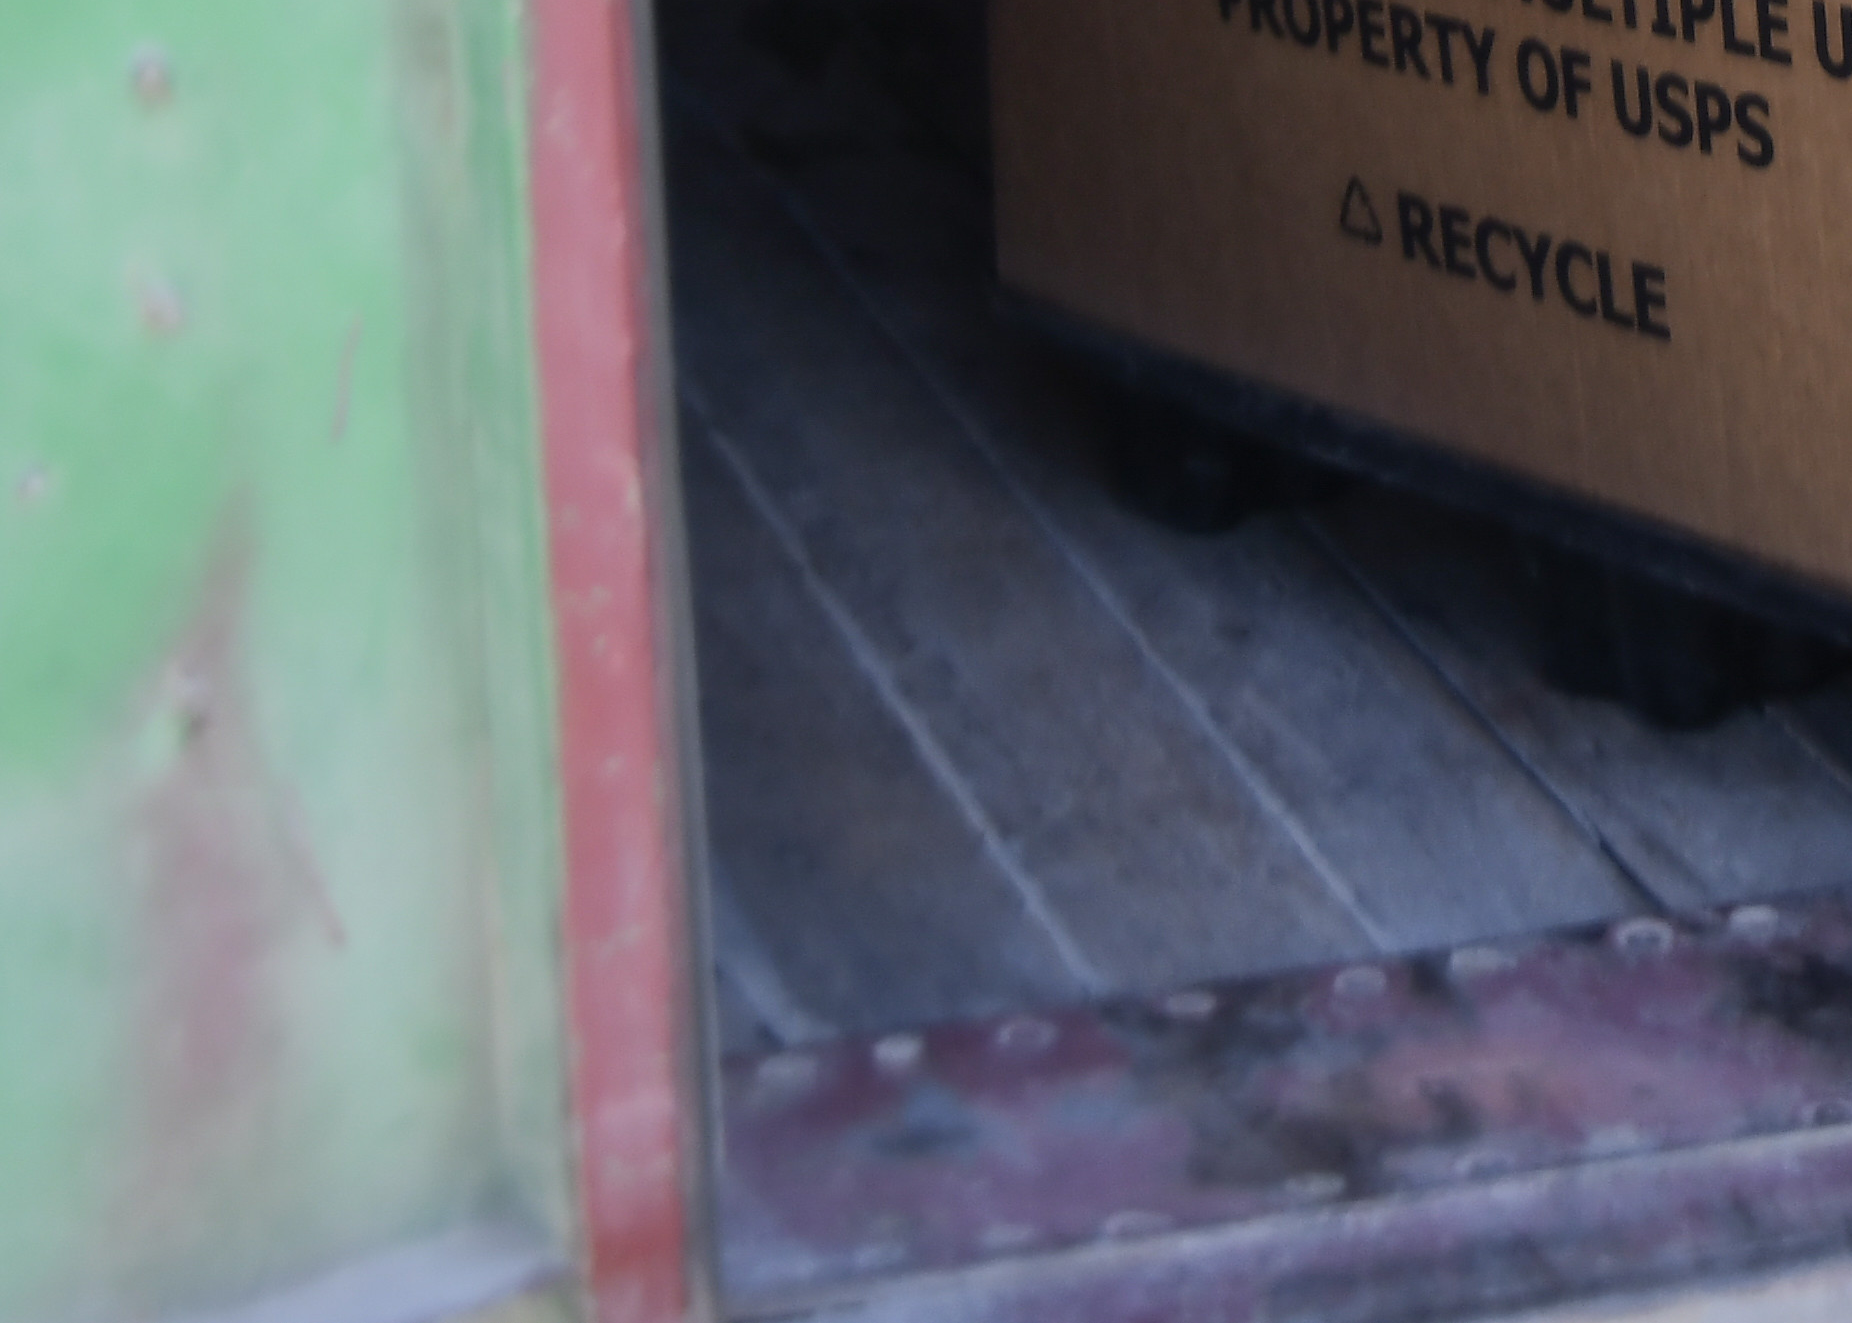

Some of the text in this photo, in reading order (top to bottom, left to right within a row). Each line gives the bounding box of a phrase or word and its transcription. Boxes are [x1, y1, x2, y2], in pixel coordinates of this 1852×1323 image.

[1515, 37, 1593, 120] OF
[1610, 58, 1777, 169] USPS
[1397, 192, 1672, 342] RECYCLE
